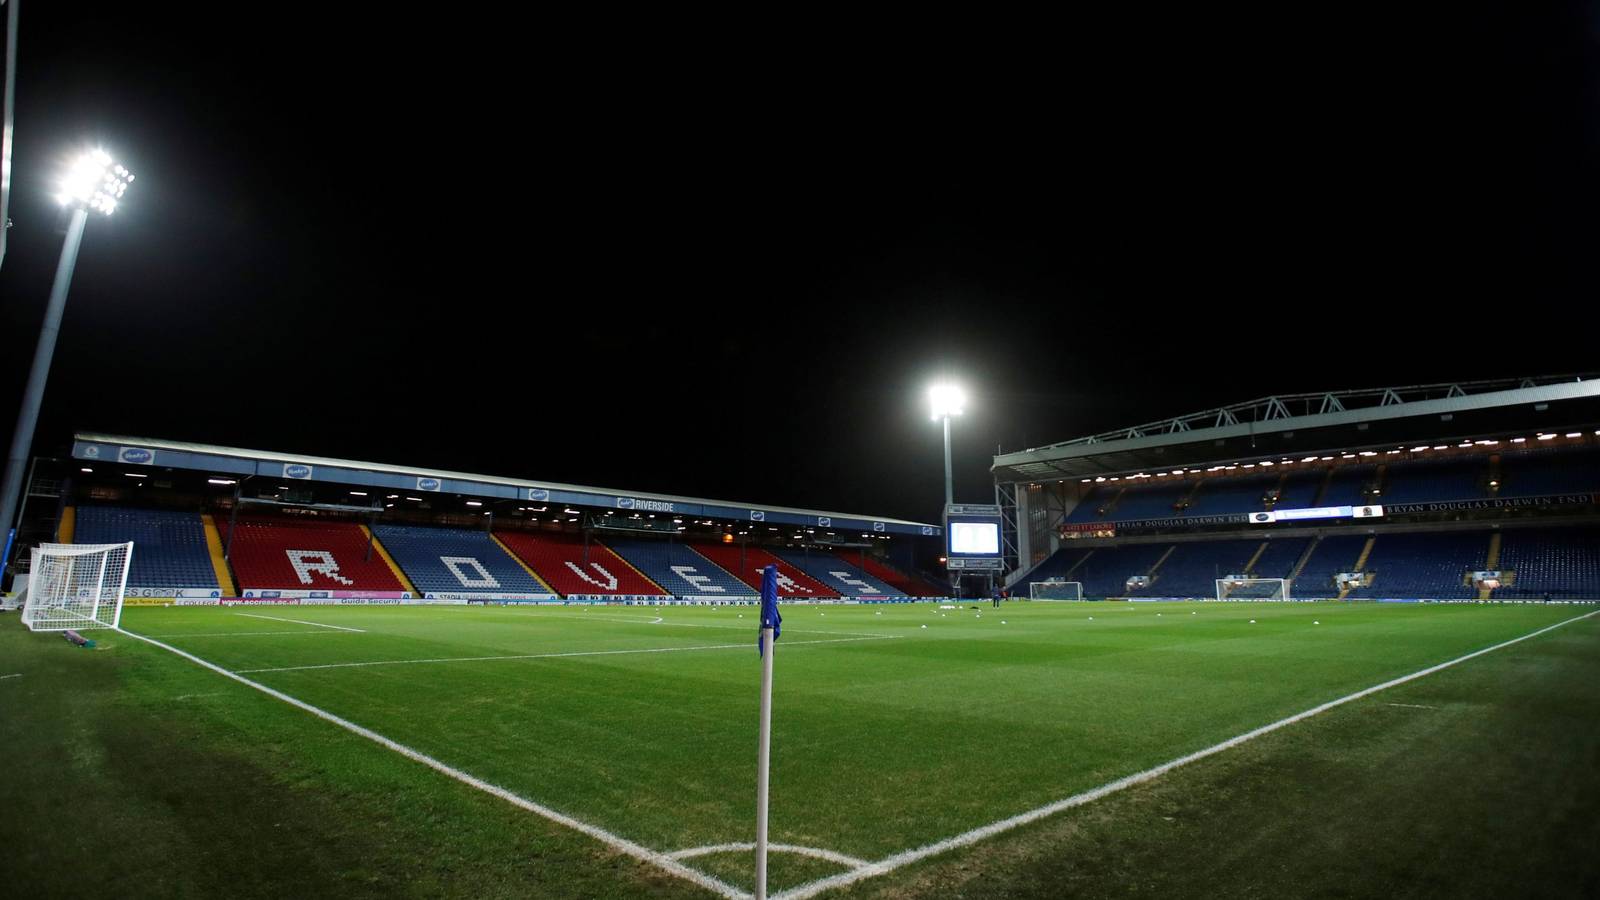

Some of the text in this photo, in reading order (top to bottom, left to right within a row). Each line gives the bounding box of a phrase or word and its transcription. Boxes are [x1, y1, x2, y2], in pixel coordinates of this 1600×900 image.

[635, 499, 674, 512] RIVERSIDE
[1387, 494, 1589, 514] BRYAN DOUGLAS DARWEN END
[1117, 521, 1142, 529] BRYAN
[1145, 519, 1185, 528] DOUGLAS
[1187, 516, 1225, 526] DARWEN
[1228, 515, 1249, 524] END
